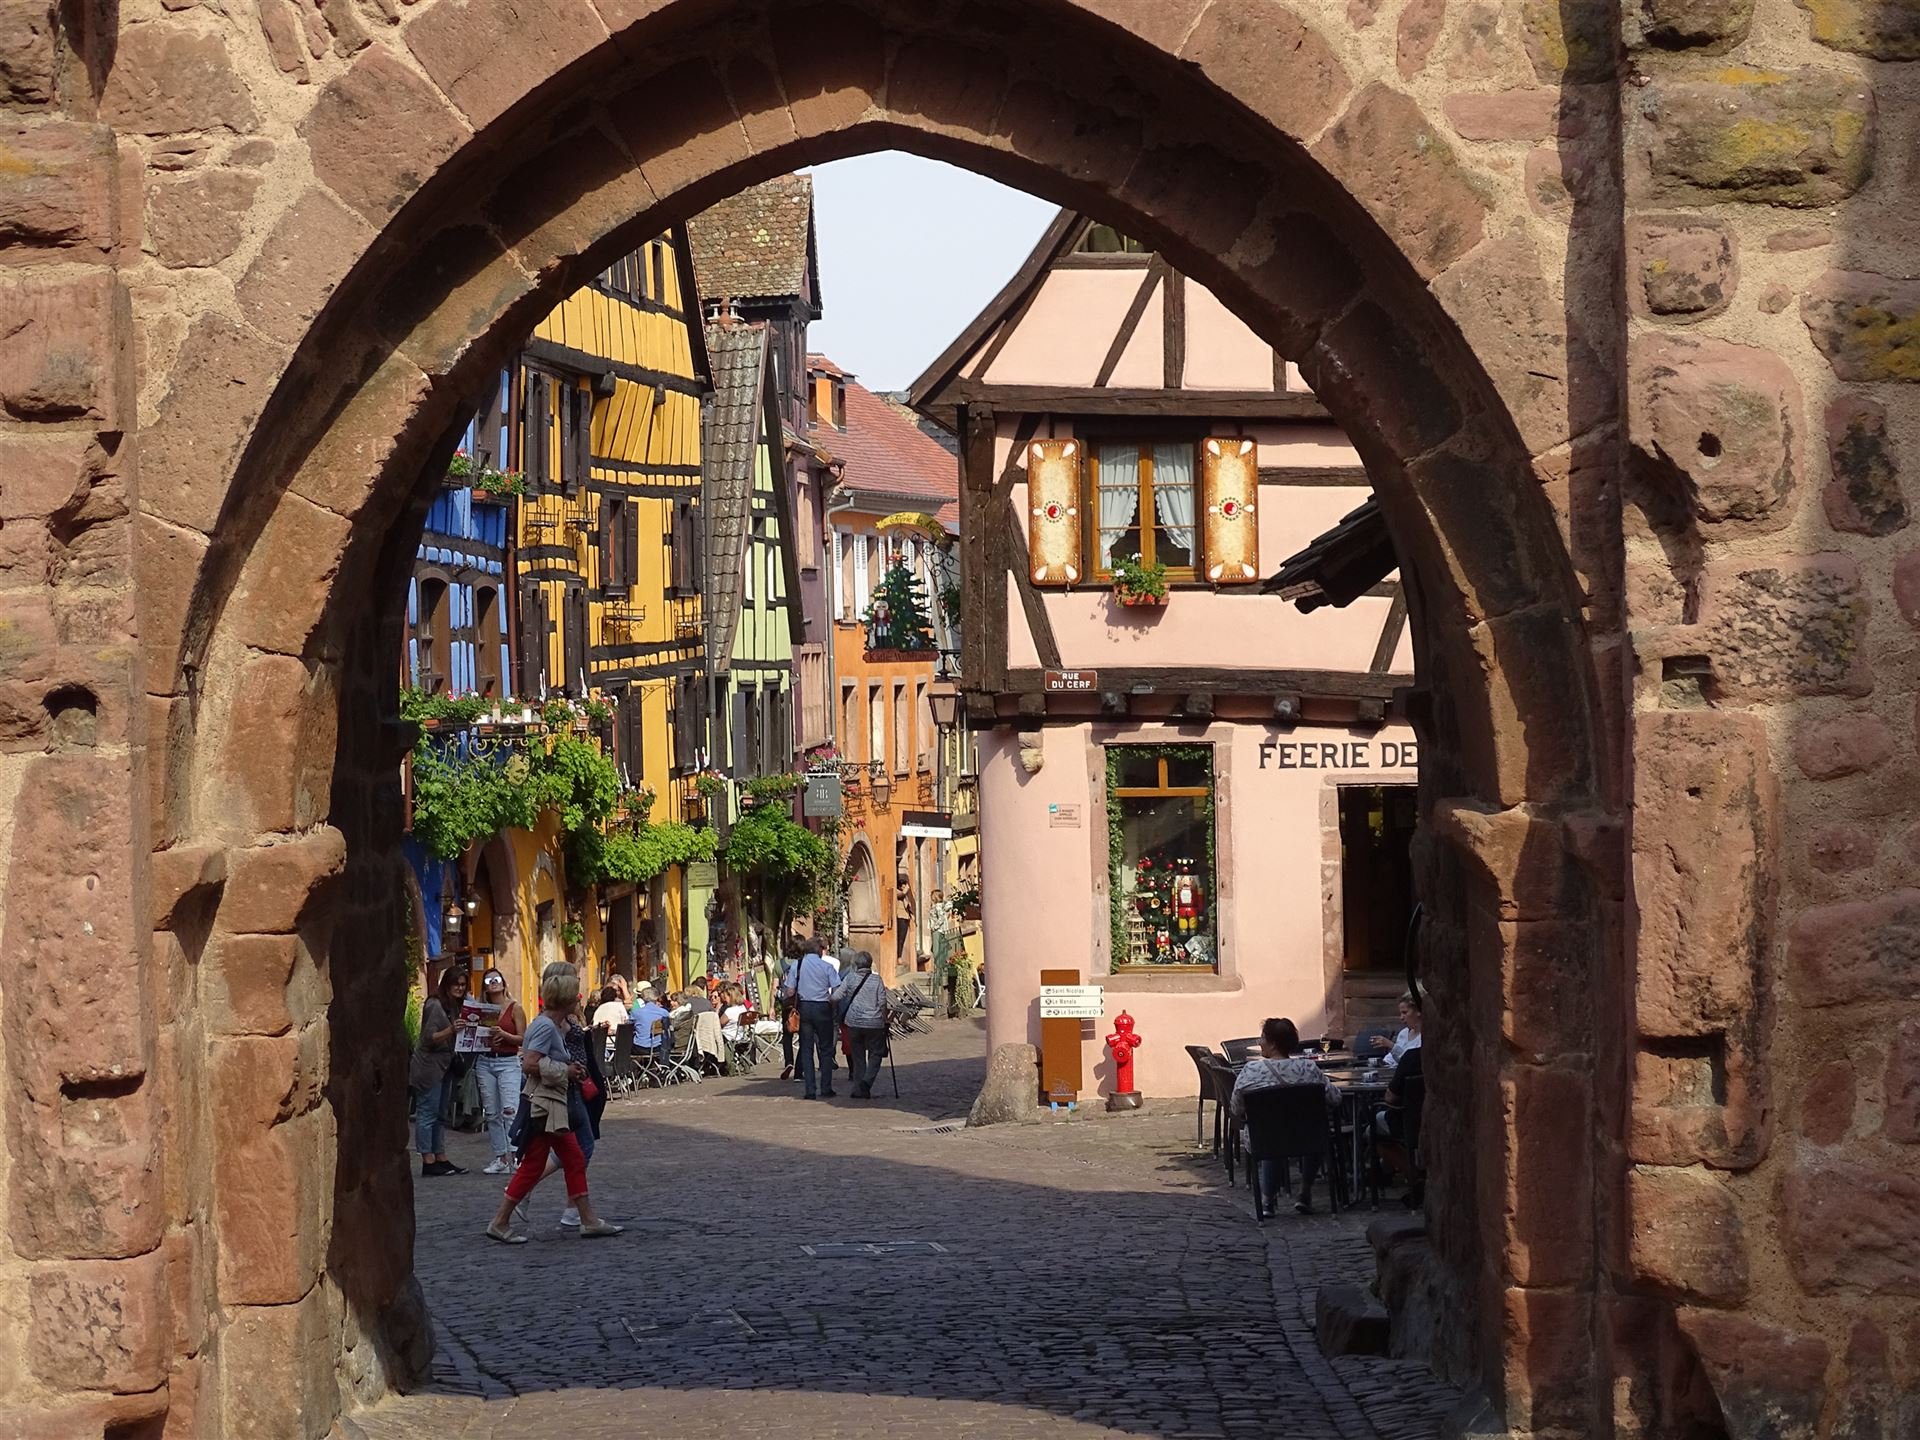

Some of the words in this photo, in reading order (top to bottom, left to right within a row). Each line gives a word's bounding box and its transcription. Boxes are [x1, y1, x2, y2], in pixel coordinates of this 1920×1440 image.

[1062, 672, 1080, 680] RUE
[1051, 680, 1064, 689] DU
[1066, 680, 1091, 689] CERF
[1258, 742, 1370, 769] FEERIE
[1380, 742, 1418, 768] DE
